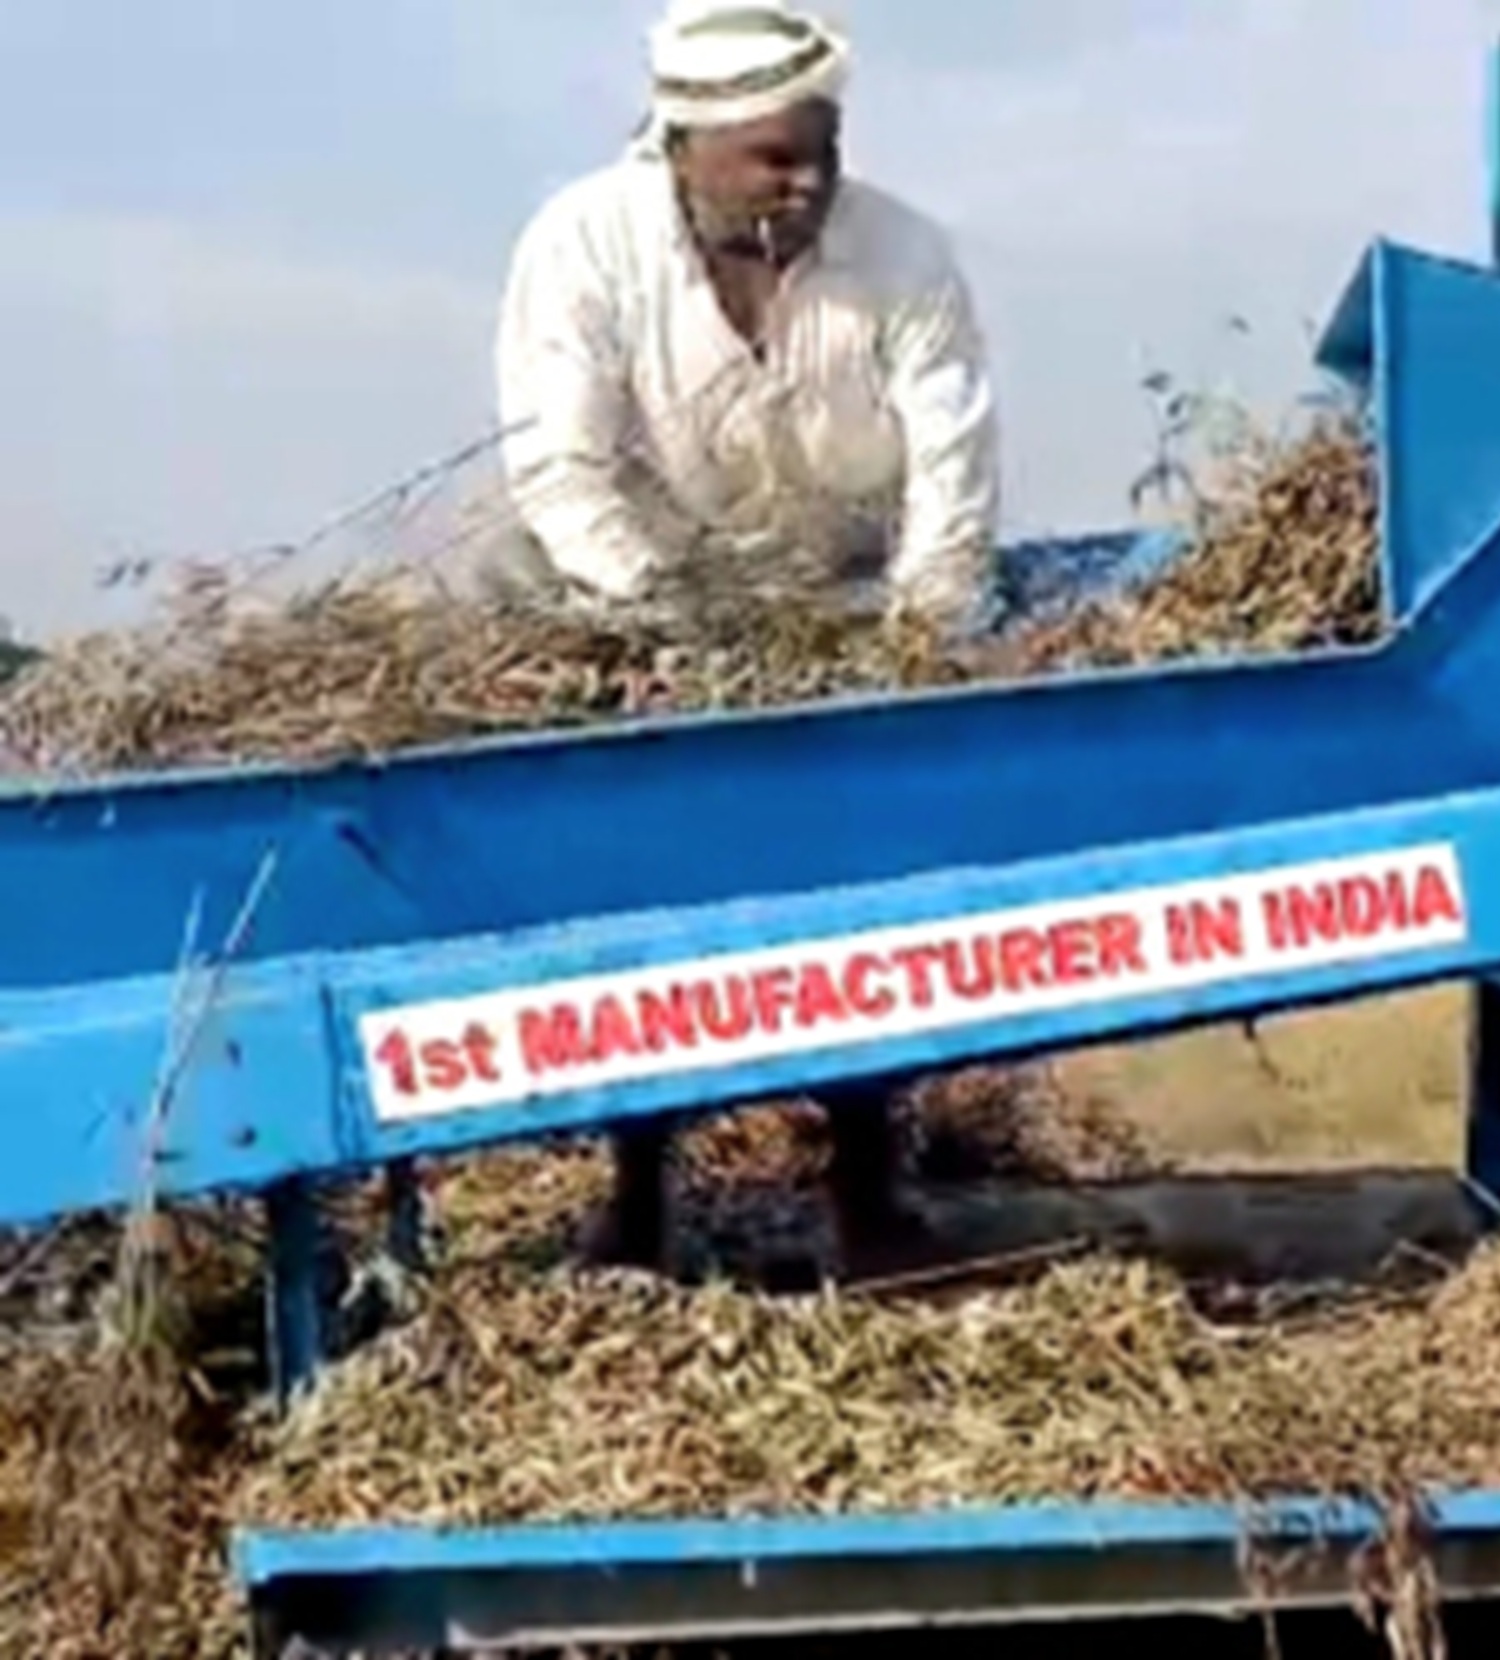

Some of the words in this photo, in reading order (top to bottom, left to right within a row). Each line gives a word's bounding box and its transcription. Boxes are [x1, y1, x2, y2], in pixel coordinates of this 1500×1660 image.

[376, 1021, 500, 1096] 1st
[517, 912, 1147, 1076] MANUFACTURER
[1164, 898, 1242, 966] IN
[1261, 865, 1460, 950] INDIA
